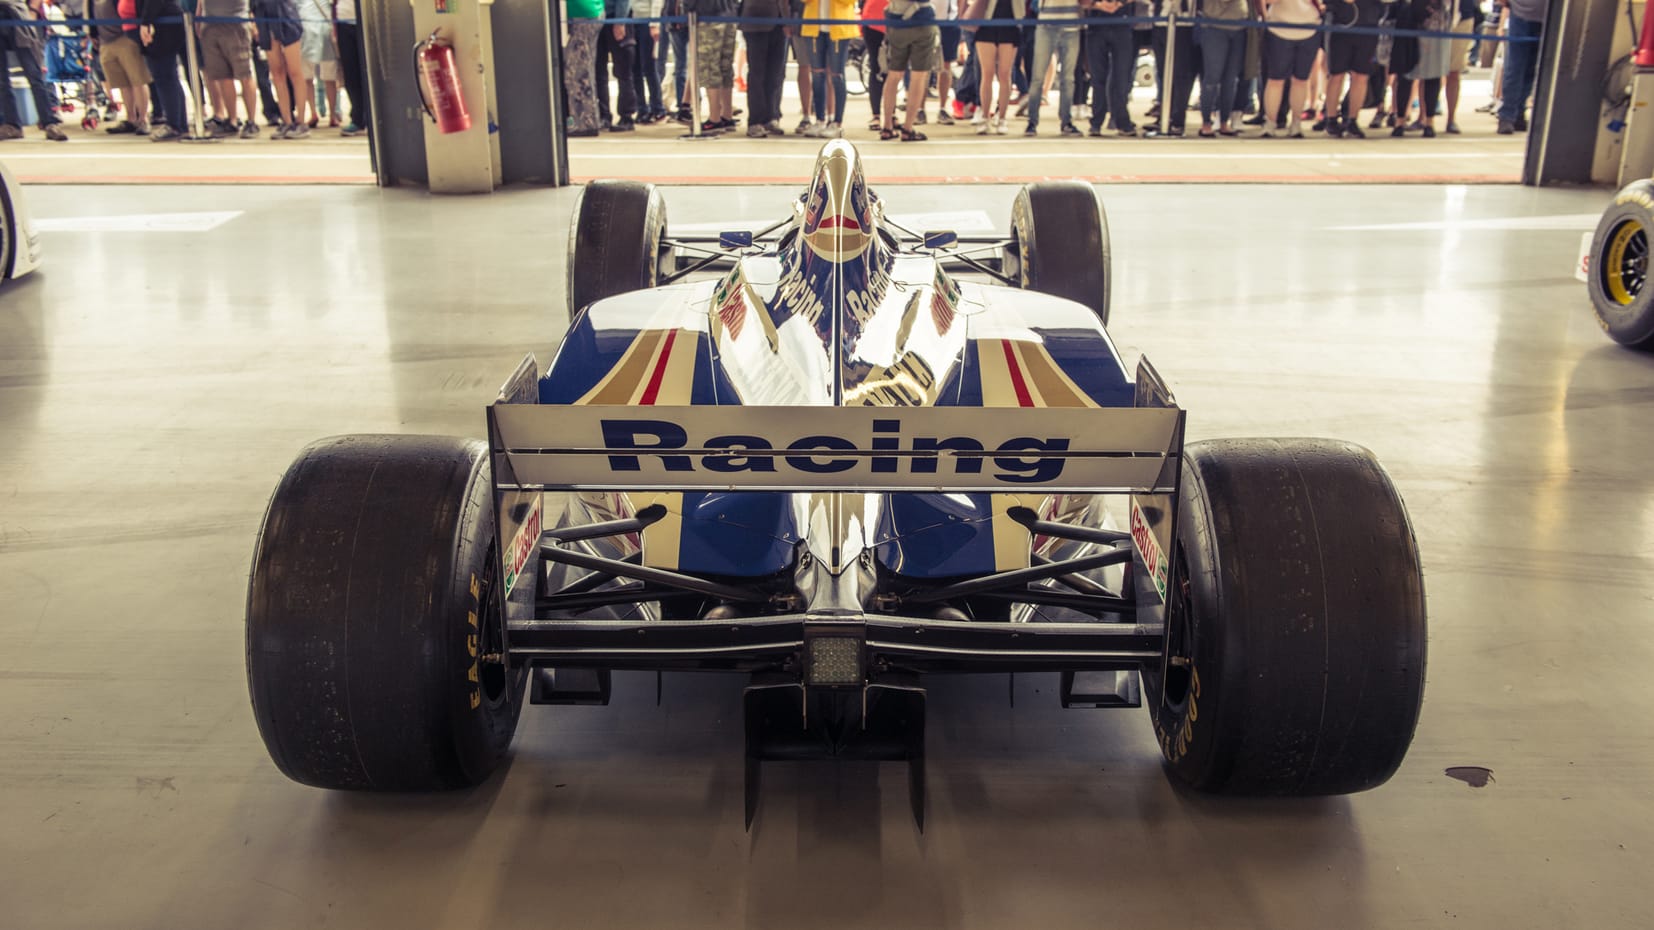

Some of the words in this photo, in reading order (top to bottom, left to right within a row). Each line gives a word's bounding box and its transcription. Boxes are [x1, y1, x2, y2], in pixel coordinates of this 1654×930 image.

[600, 419, 1071, 483] Racing
[514, 508, 541, 575] Castrol
[1131, 505, 1159, 577] Castrol
[467, 573, 481, 710] EAGLE
